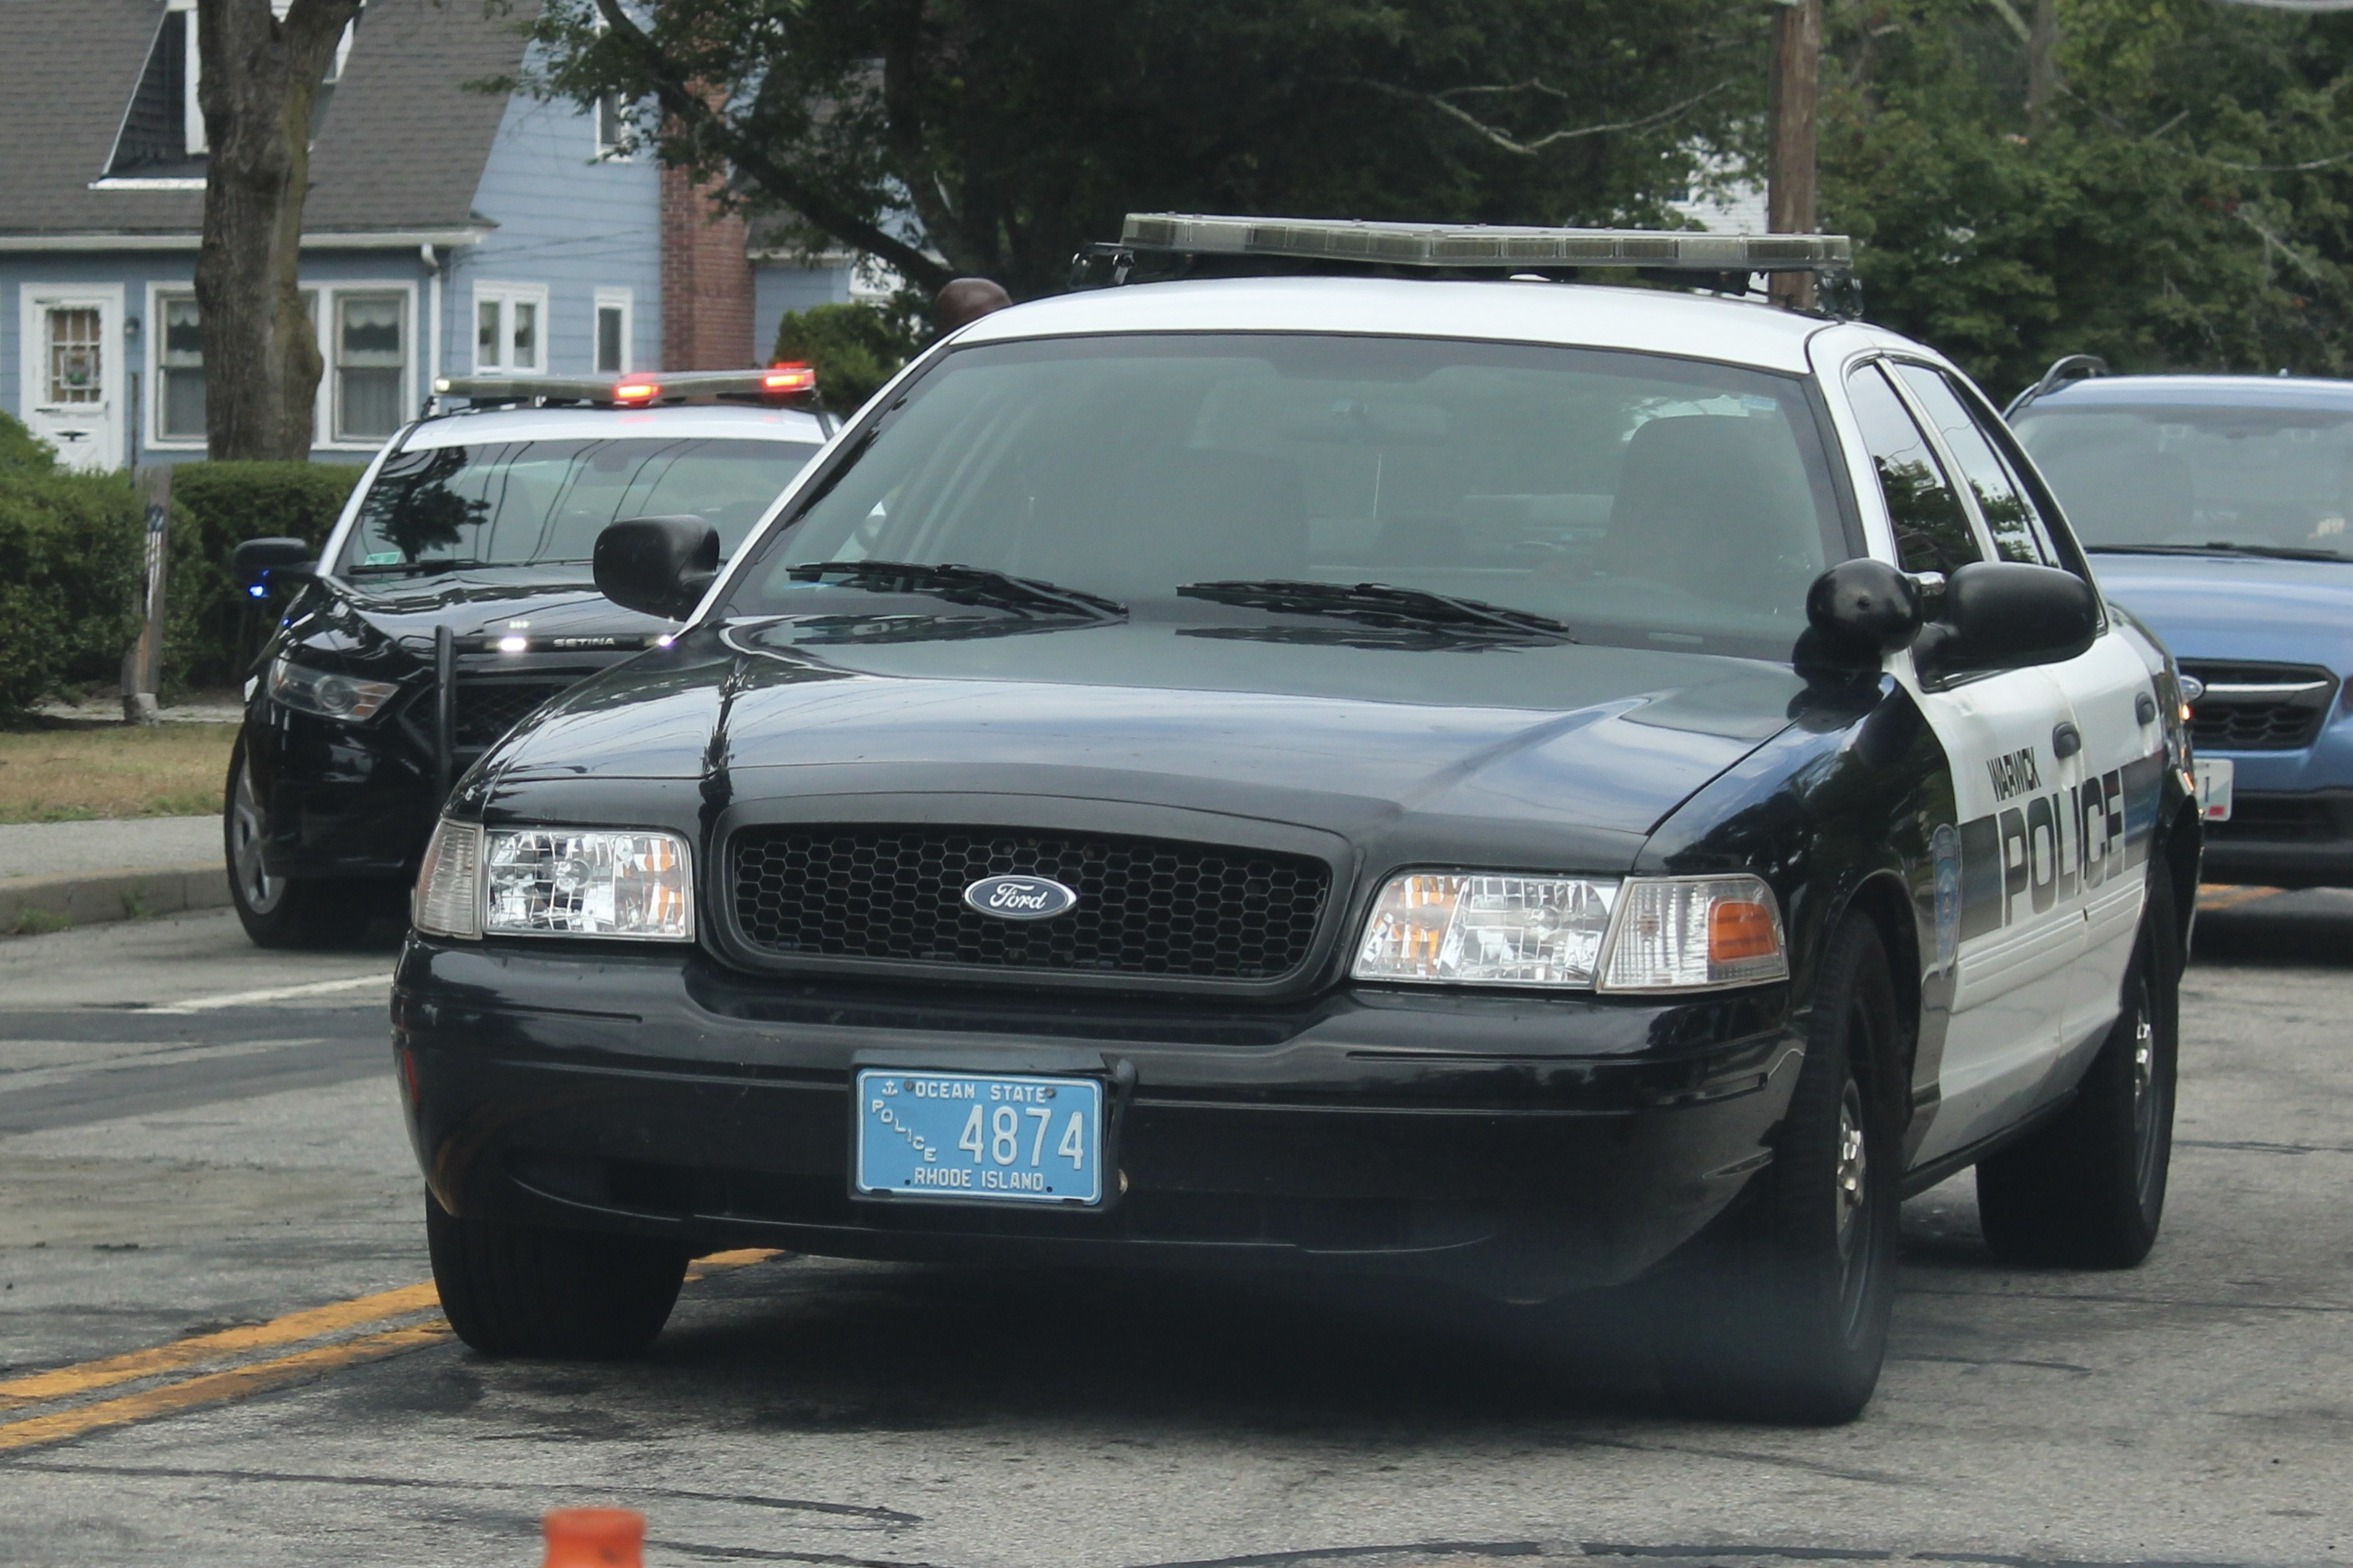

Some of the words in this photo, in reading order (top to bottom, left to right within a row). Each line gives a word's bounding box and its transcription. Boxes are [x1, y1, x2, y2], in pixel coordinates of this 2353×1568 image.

[553, 638, 616, 648] SETINA
[1986, 746, 2042, 802] WARWICK
[1999, 769, 2124, 927] POLICE
[989, 883, 1048, 909] Ford
[915, 1081, 976, 1099] OCEAN
[990, 1085, 1047, 1103] STATE
[871, 1099, 937, 1162] POLICE
[958, 1104, 1084, 1171] 4874
[914, 1167, 972, 1187] RHODE
[982, 1171, 1044, 1192] ISLAND
